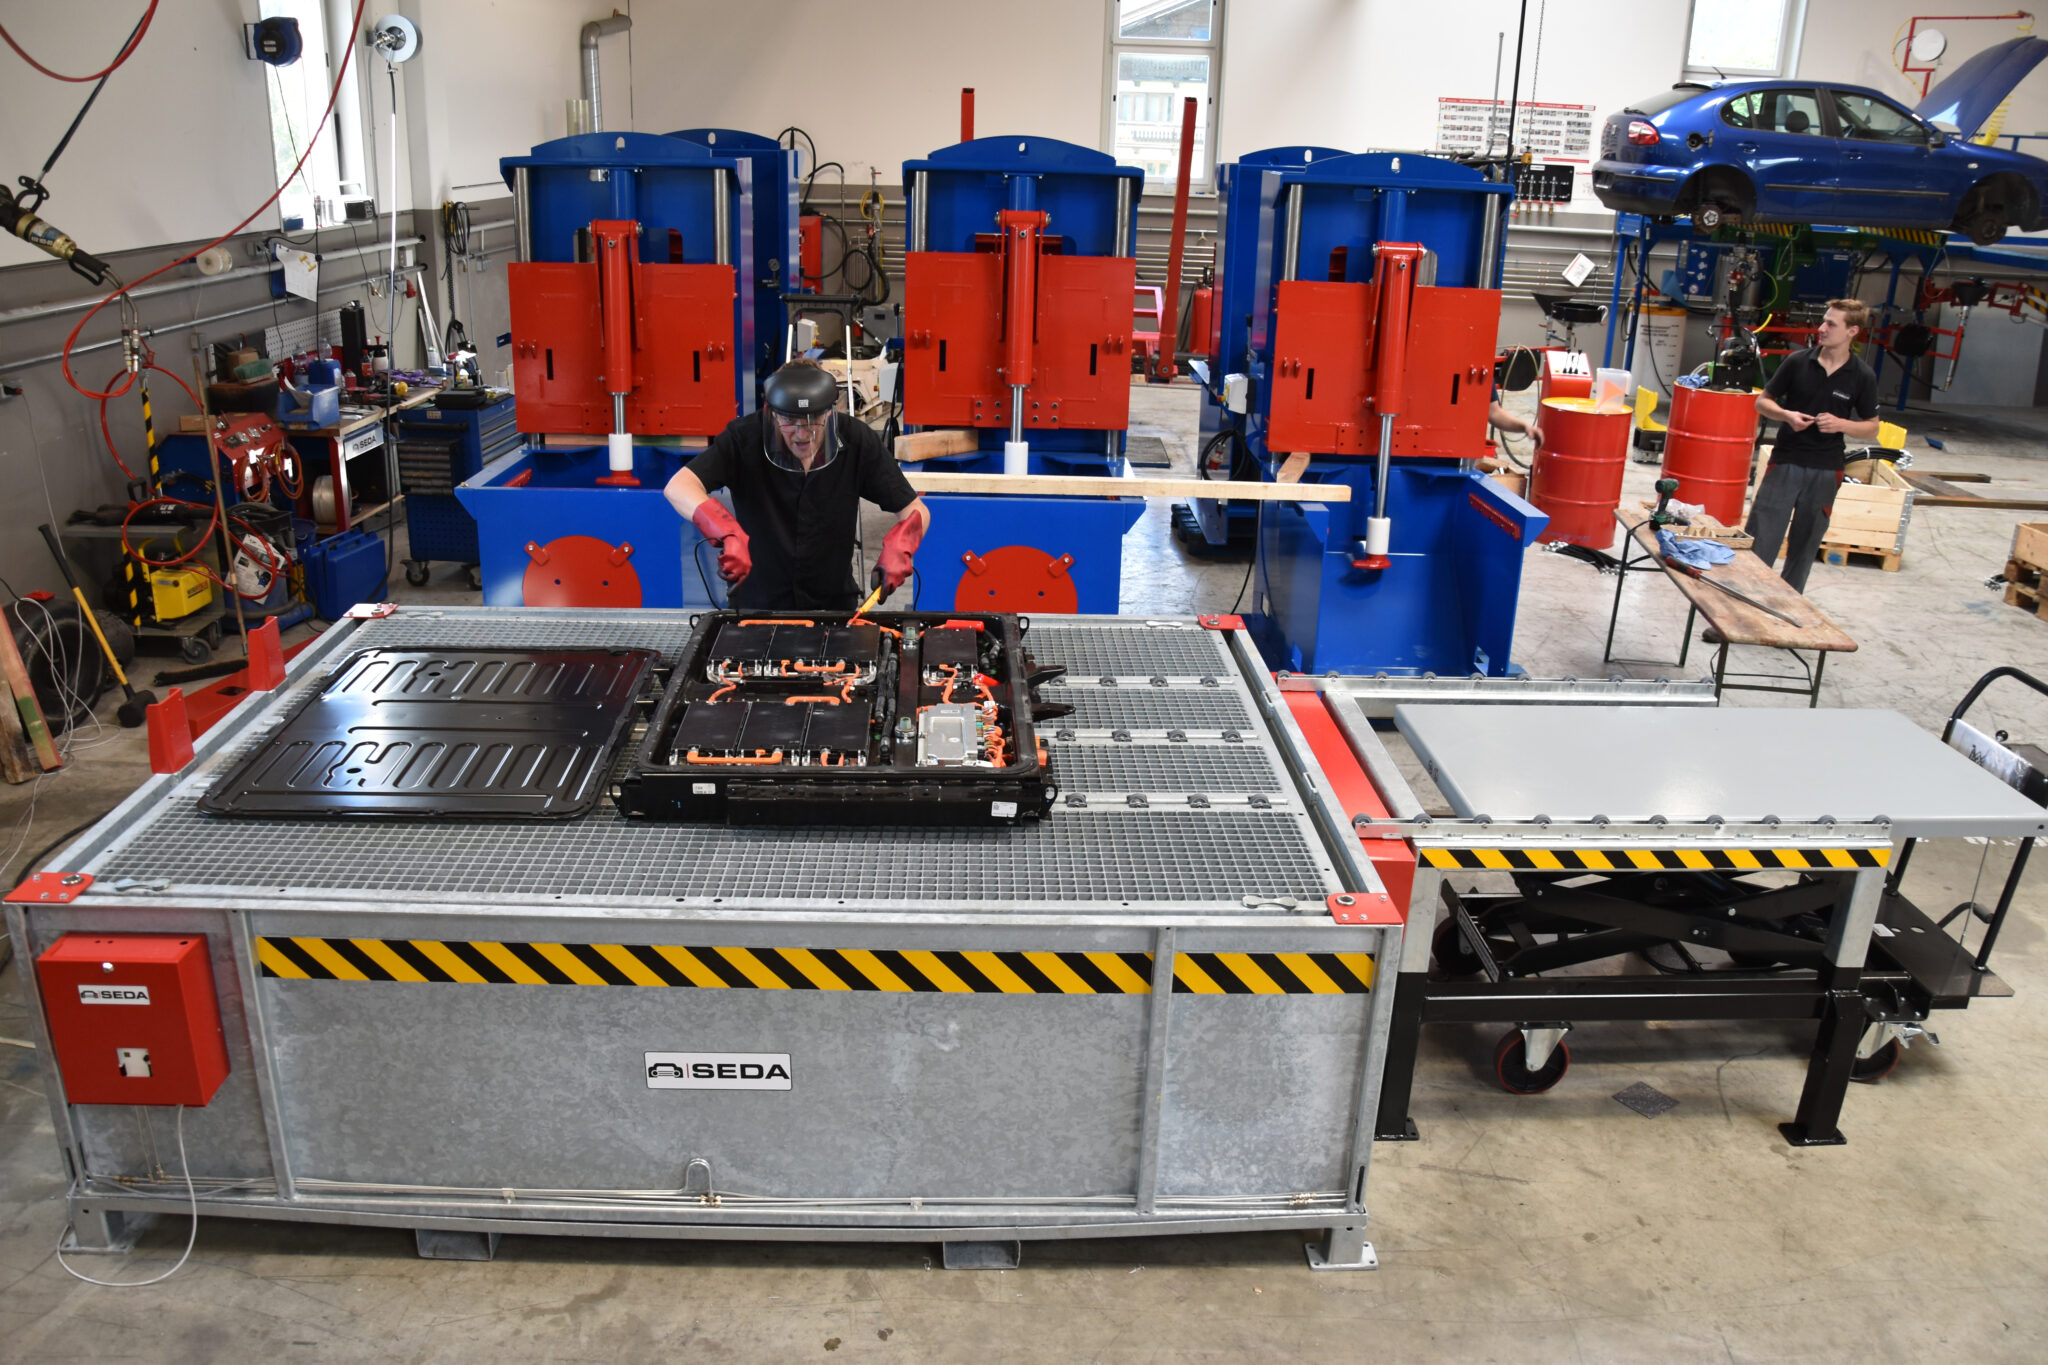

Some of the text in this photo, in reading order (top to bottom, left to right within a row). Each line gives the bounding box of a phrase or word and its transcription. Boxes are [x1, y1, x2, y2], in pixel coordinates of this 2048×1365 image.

[359, 435, 377, 449] SEDA
[101, 990, 148, 1000] SEDA
[692, 1063, 790, 1080] SEDA
